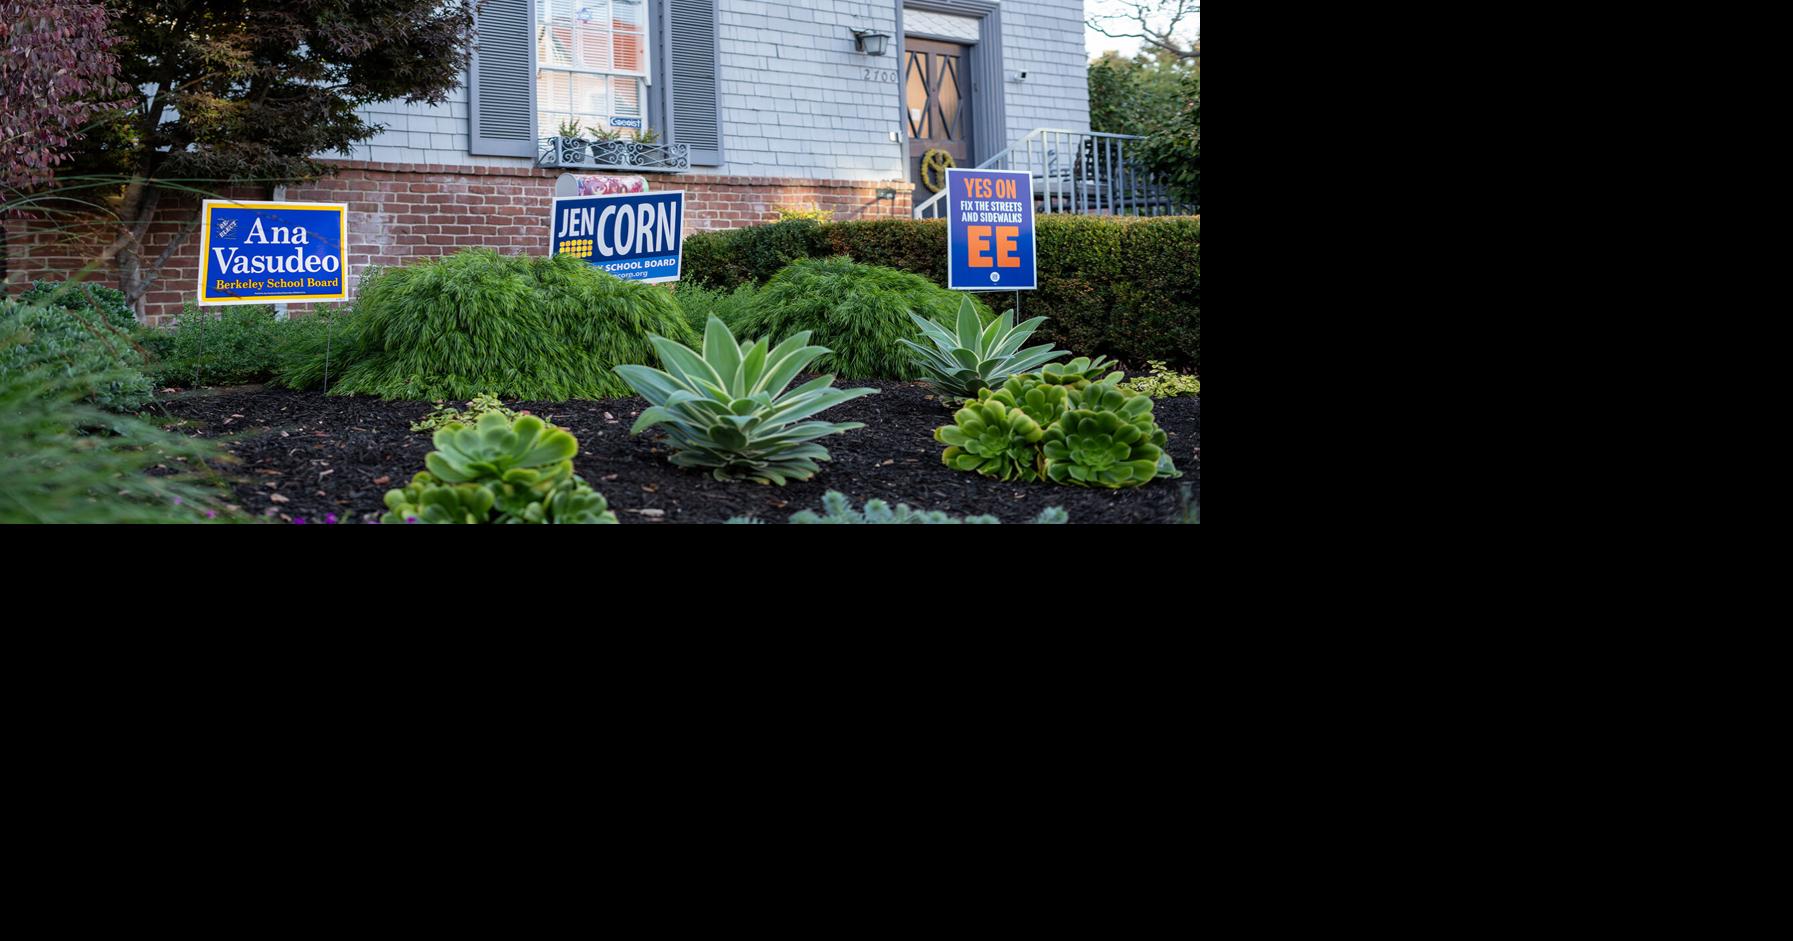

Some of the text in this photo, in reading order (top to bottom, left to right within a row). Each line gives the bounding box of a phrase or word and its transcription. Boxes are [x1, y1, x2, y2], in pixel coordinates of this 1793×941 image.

[864, 68, 896, 81] 2700
[964, 178, 1017, 199] YES ON
[961, 201, 1022, 212] FIX THE STREETS
[961, 212, 1022, 223] AND SIDEWALKS
[244, 217, 309, 245] Ana
[558, 201, 677, 257] JEN CORN
[967, 225, 1020, 268] EE
[212, 247, 339, 275] Vasudeo
[605, 262, 642, 272] SCHOOL
[644, 258, 676, 268] BOARD
[216, 278, 338, 290] Berkeley School Board
